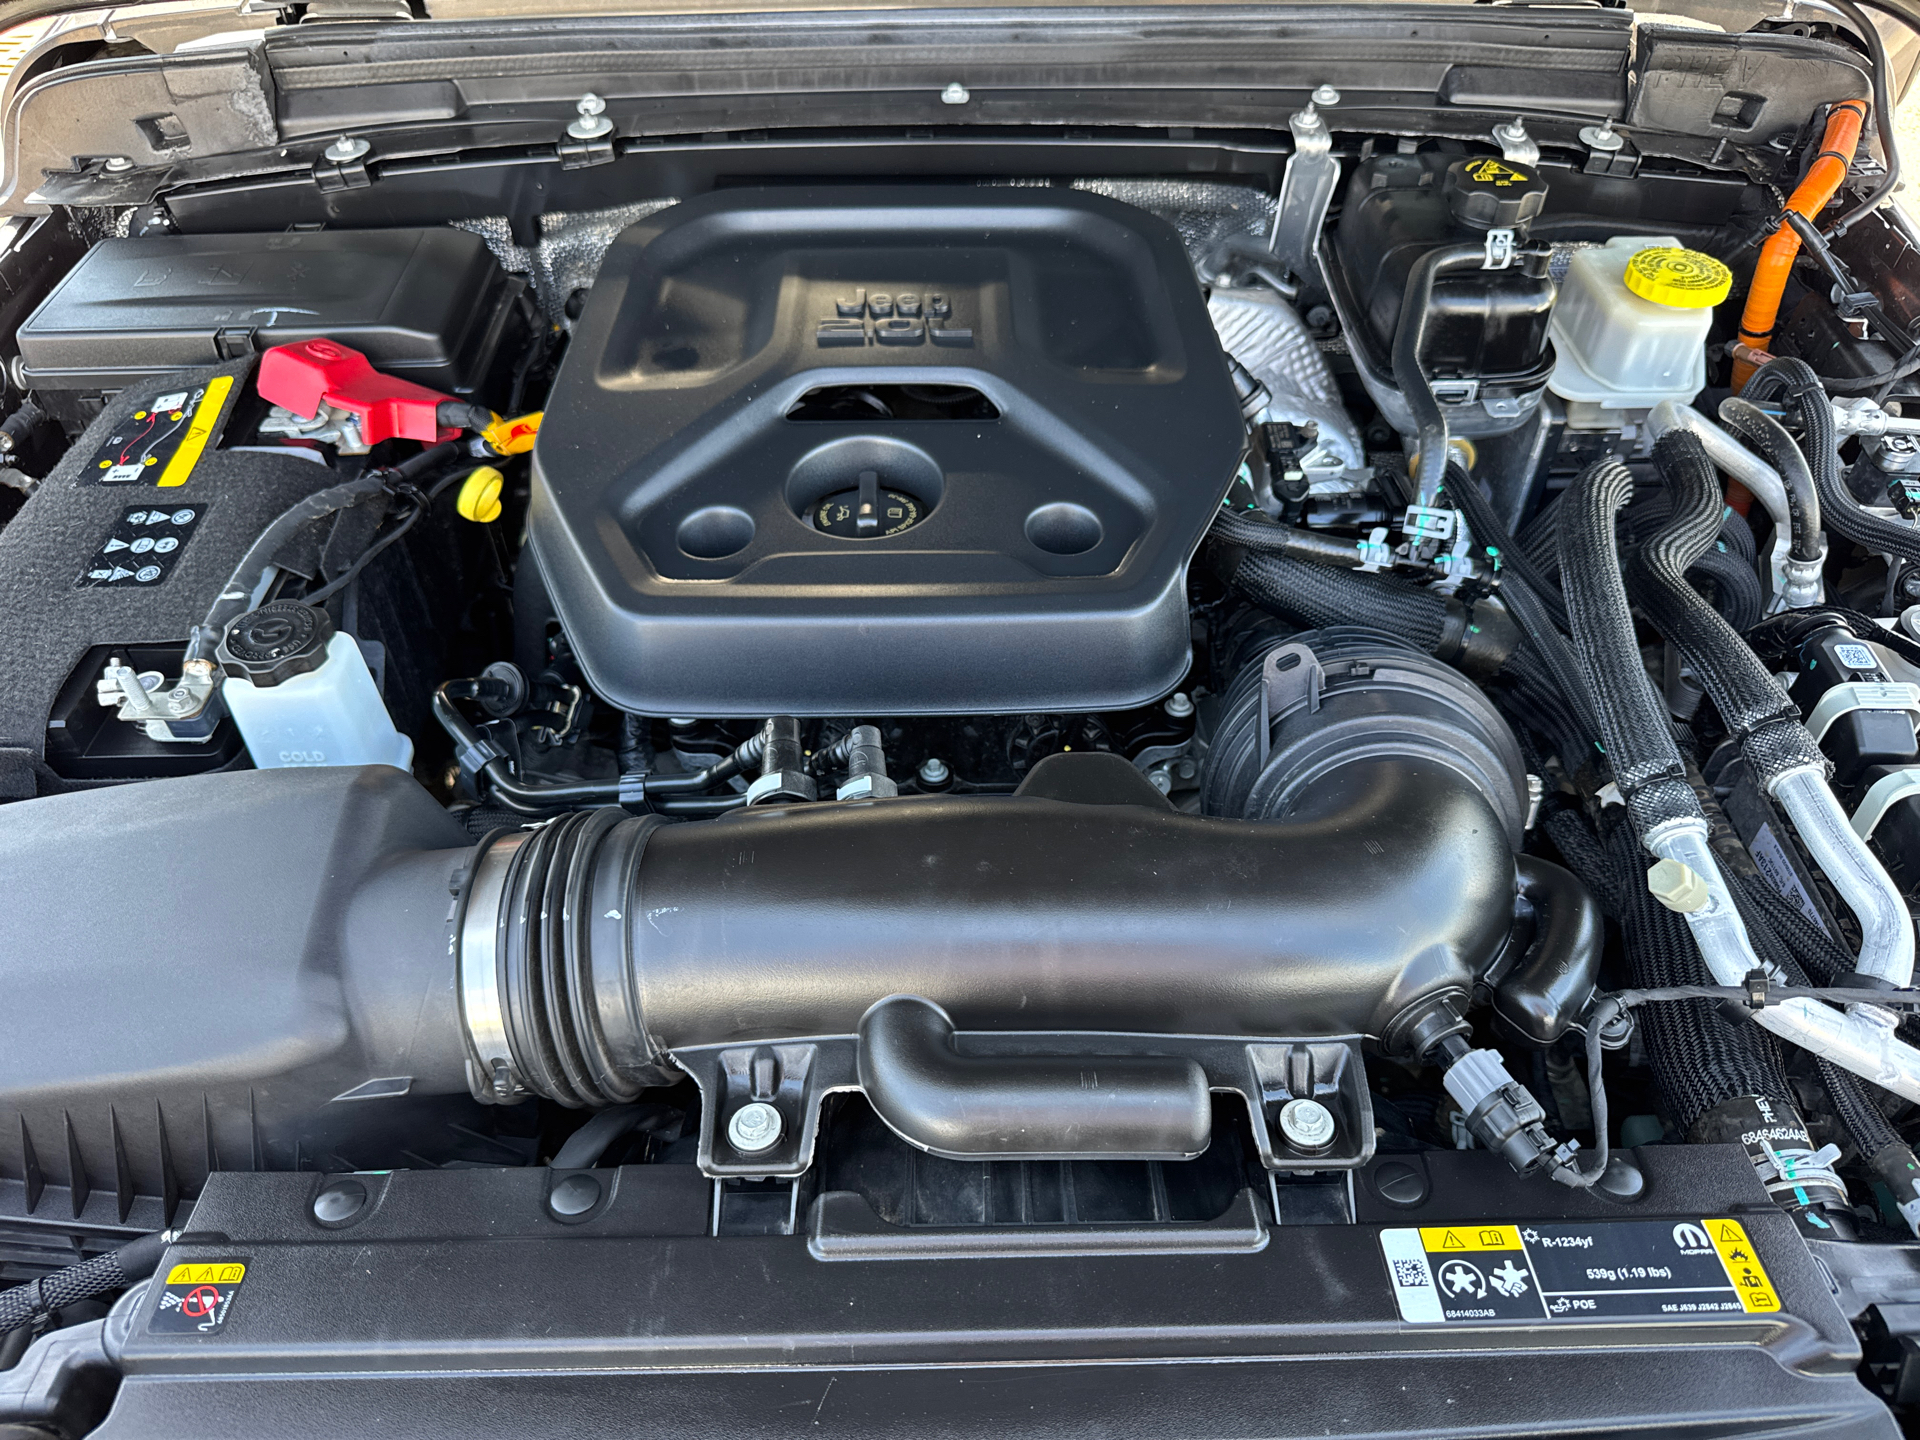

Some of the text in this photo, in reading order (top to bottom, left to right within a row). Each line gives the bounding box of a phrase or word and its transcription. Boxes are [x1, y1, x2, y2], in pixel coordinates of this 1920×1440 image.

[836, 288, 951, 318] Jeep
[816, 317, 973, 347] 2.0L
[278, 750, 326, 763] COLD
[1541, 1235, 1594, 1250] R-1234yf
[1586, 1265, 1672, 1281] 539g (1.19 lbs)
[1571, 1298, 1597, 1310] POE
[1661, 1303, 1678, 1313] SAE
[1445, 1309, 1496, 1318] 68414033AB
